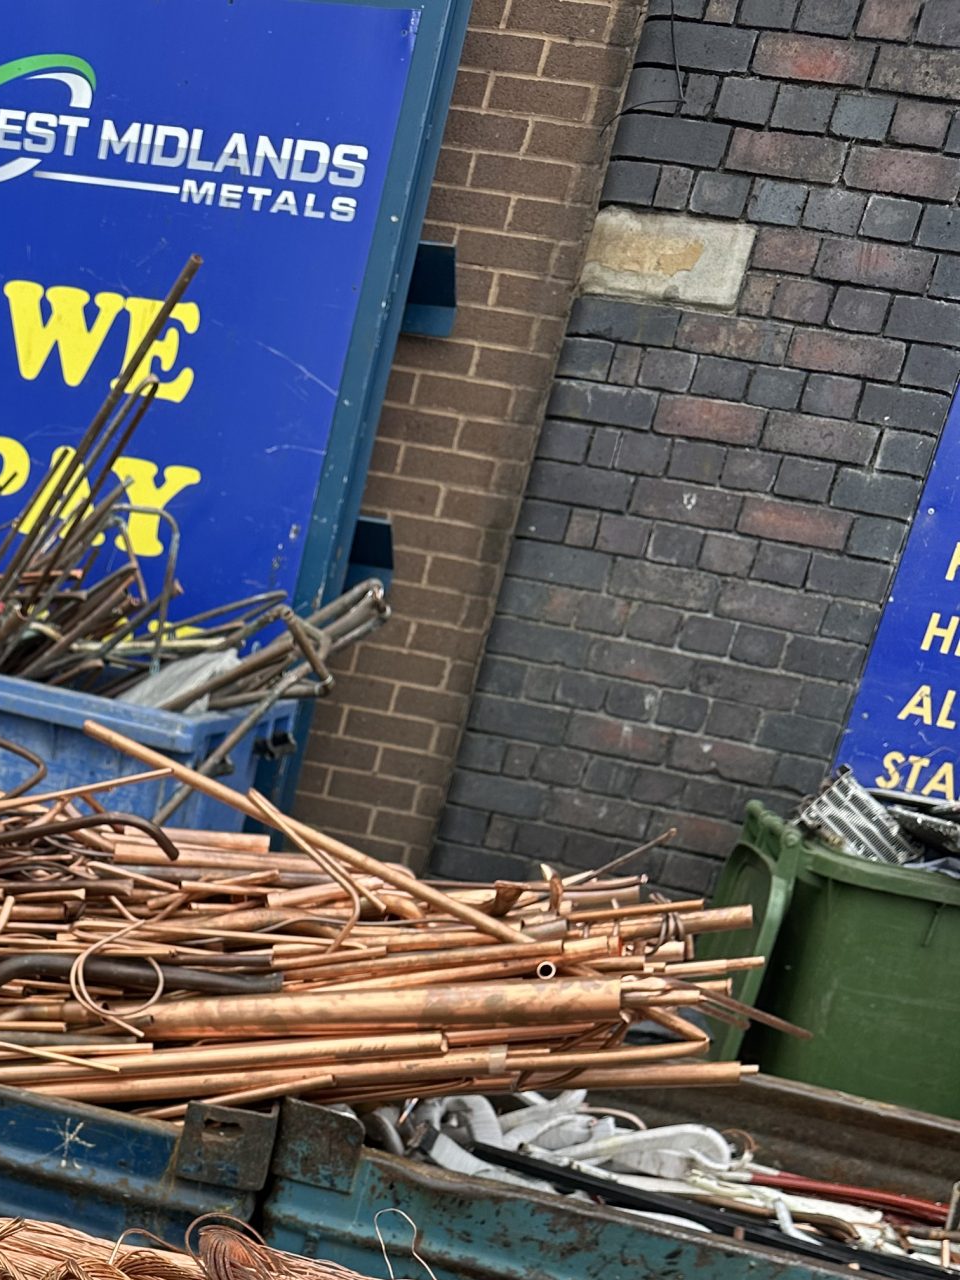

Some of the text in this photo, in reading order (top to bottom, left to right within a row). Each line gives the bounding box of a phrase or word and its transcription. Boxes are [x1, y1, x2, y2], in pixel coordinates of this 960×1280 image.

[97, 119, 369, 188] MIDLANDS
[180, 179, 358, 222] METALS
[3, 280, 200, 403] WE
[920, 612, 960, 657] H
[897, 684, 956, 729] AL
[875, 751, 955, 801] STA
